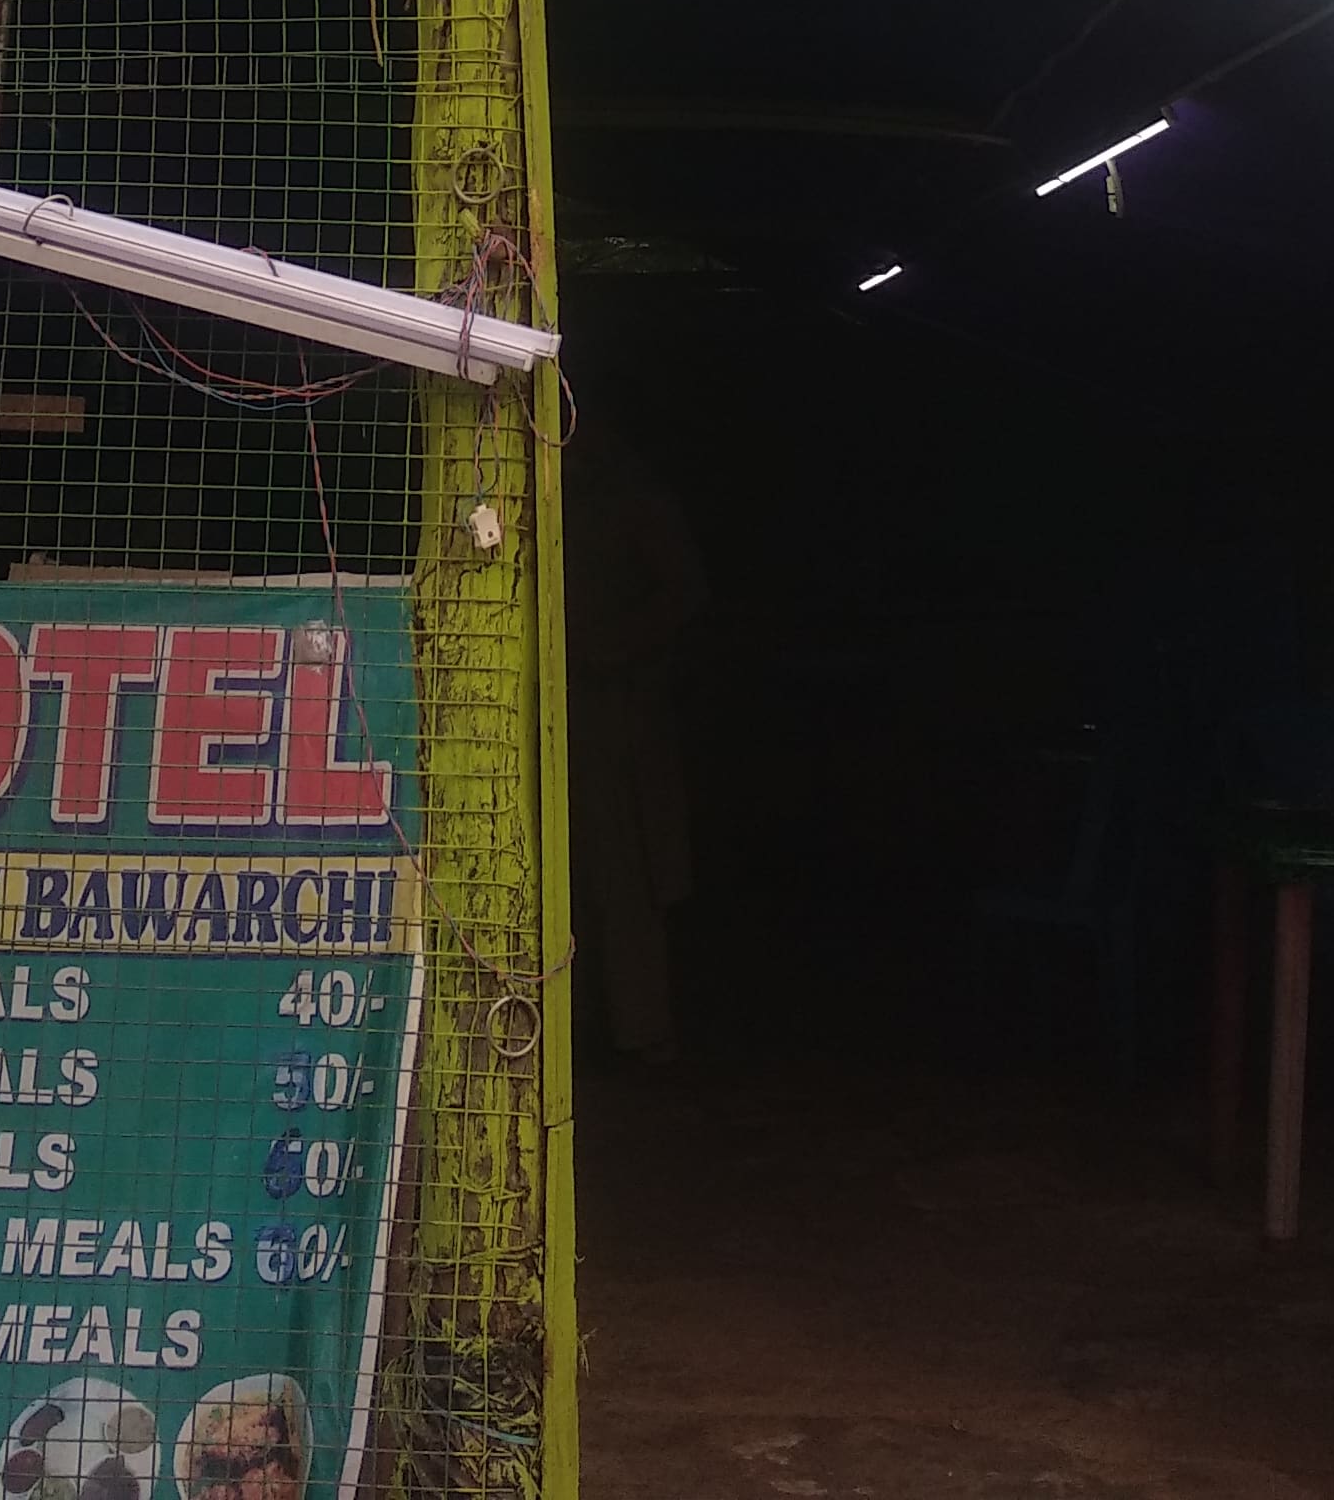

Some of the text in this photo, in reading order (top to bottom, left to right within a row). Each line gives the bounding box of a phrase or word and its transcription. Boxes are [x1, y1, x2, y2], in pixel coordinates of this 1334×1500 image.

[20, 867, 396, 945] BAWARCHI
[278, 968, 385, 1027] 40/-
[0, 1217, 234, 1283] MEALS
